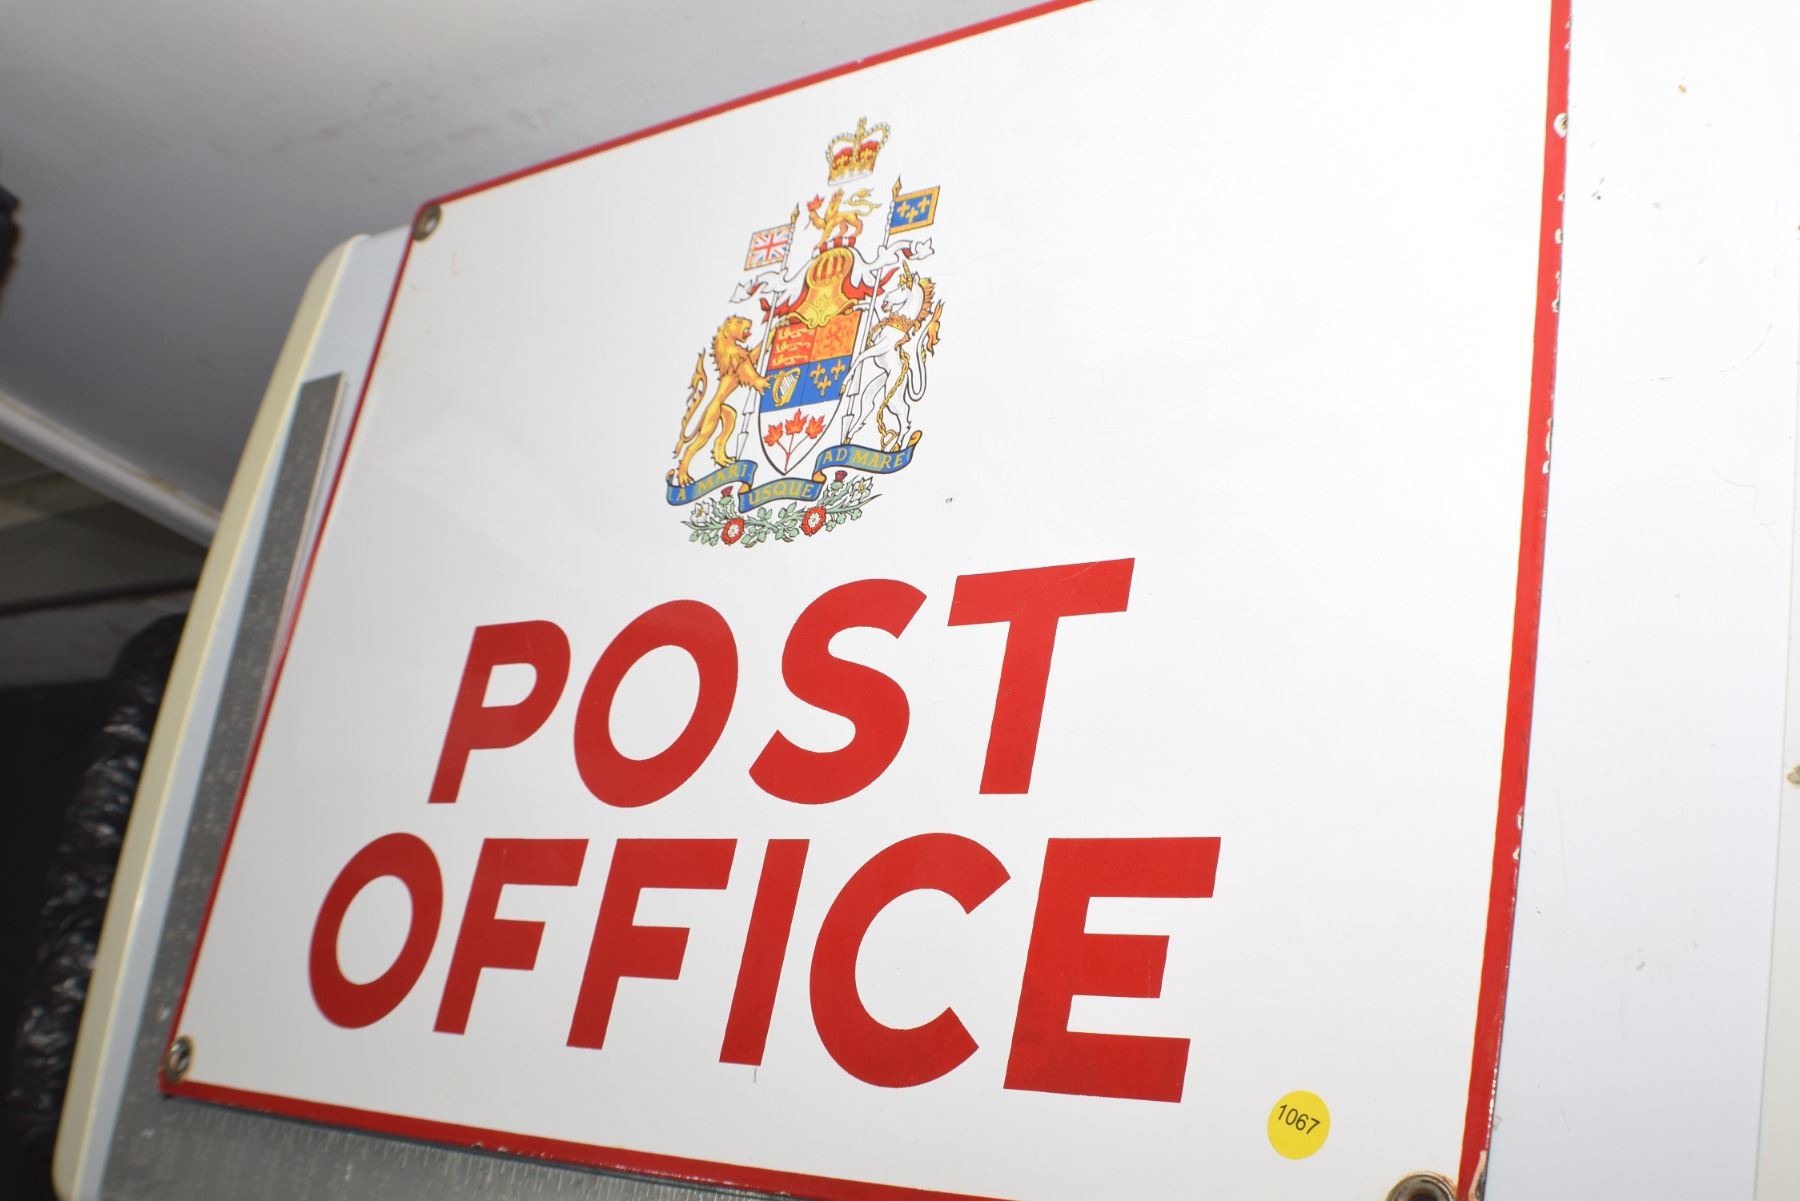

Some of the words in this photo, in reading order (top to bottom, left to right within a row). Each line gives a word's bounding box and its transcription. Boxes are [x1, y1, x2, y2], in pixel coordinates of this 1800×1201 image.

[677, 487, 688, 501] A
[699, 462, 749, 492] MARI
[749, 481, 815, 504] USQUE
[821, 447, 849, 464] AD
[854, 453, 905, 470] MARE
[430, 558, 1134, 807] POST
[311, 833, 1220, 1102] OFFICE
[1278, 1104, 1321, 1135] 1067
